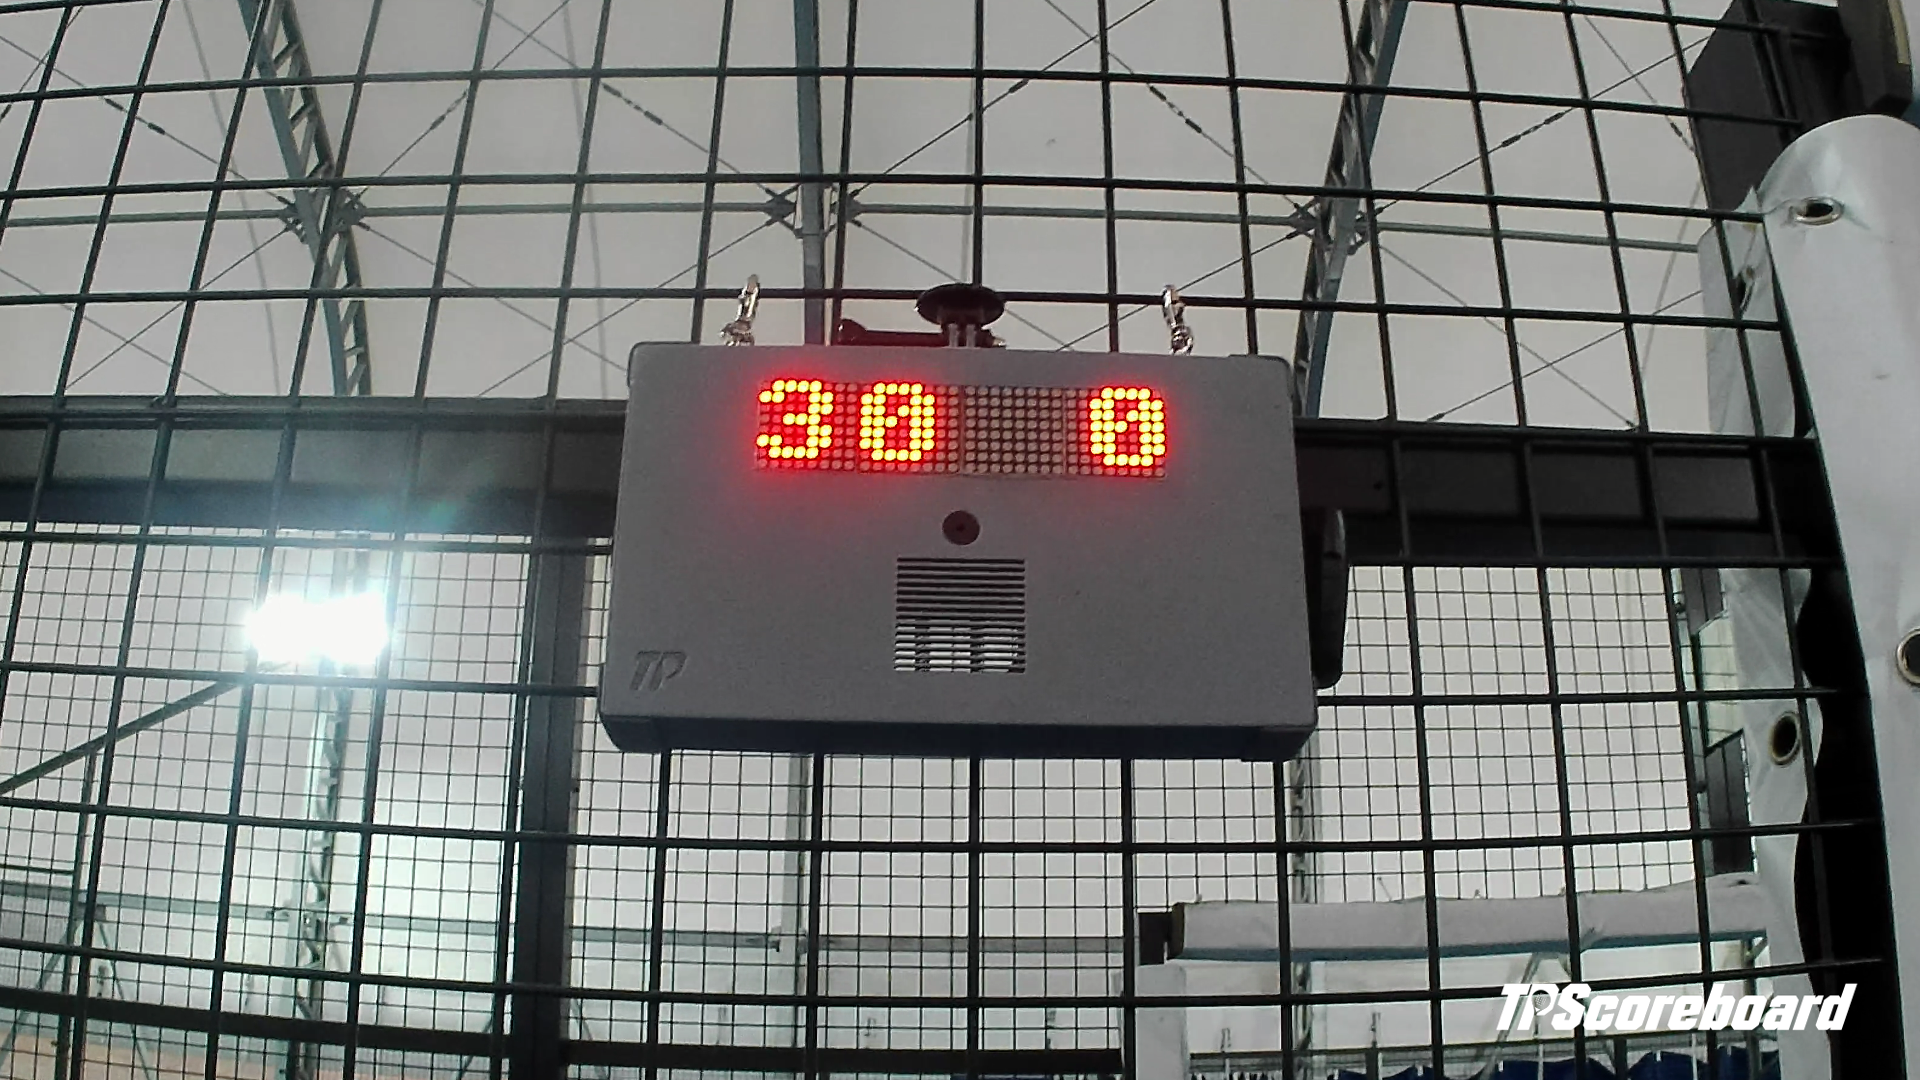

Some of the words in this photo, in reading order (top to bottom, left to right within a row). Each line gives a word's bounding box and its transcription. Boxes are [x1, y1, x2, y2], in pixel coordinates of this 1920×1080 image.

[757, 378, 936, 462] 30
[1089, 385, 1167, 468] 0
[630, 650, 687, 691] TP
